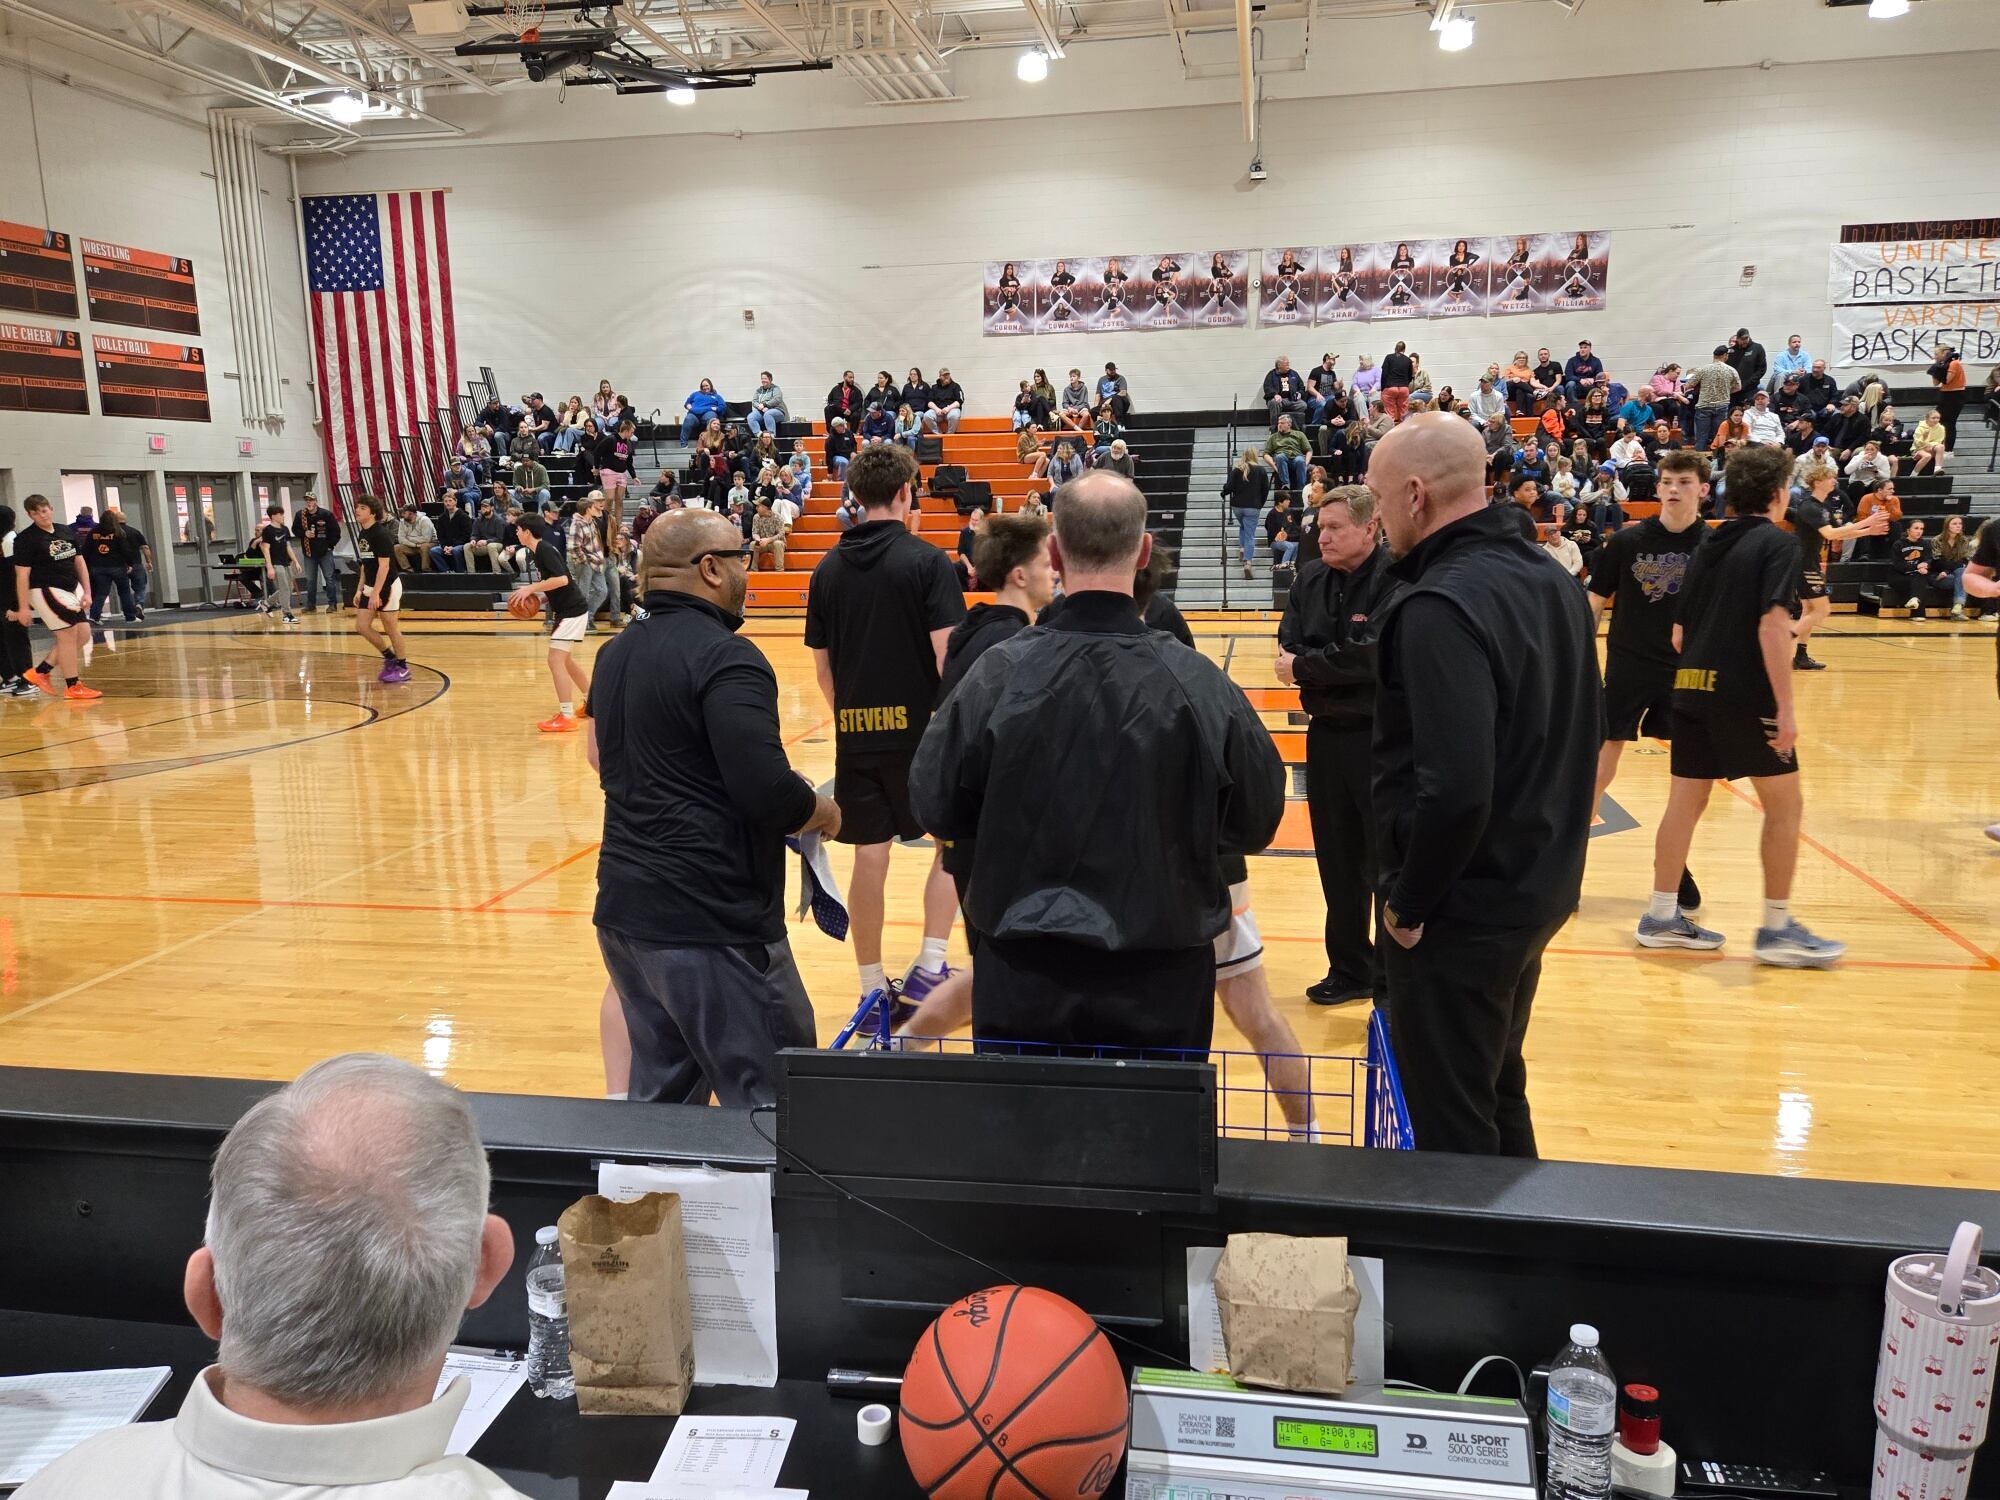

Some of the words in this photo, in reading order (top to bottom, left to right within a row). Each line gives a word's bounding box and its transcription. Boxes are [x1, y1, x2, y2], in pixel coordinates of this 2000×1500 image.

[82, 240, 130, 260] WRESTLING
[1880, 240, 1996, 264] UNIFIE
[20, 328, 52, 344] CHEER
[94, 336, 151, 355] VOLLEYBALL
[840, 706, 908, 732] STEVENS
[982, 1413, 994, 1426] G
[1179, 1412, 1198, 1421] SCAN
[1178, 1420, 1212, 1428] OPERATION
[1280, 1422, 1302, 1434] TIME
[1448, 1432, 1468, 1444] ALL
[1471, 1434, 1508, 1447] SPORT
[1448, 1444, 1474, 1456] 5000
[1476, 1446, 1508, 1458] SERIES
[1448, 1456, 1478, 1464] CONTROL
[1478, 1459, 1510, 1467] CONSOLE
